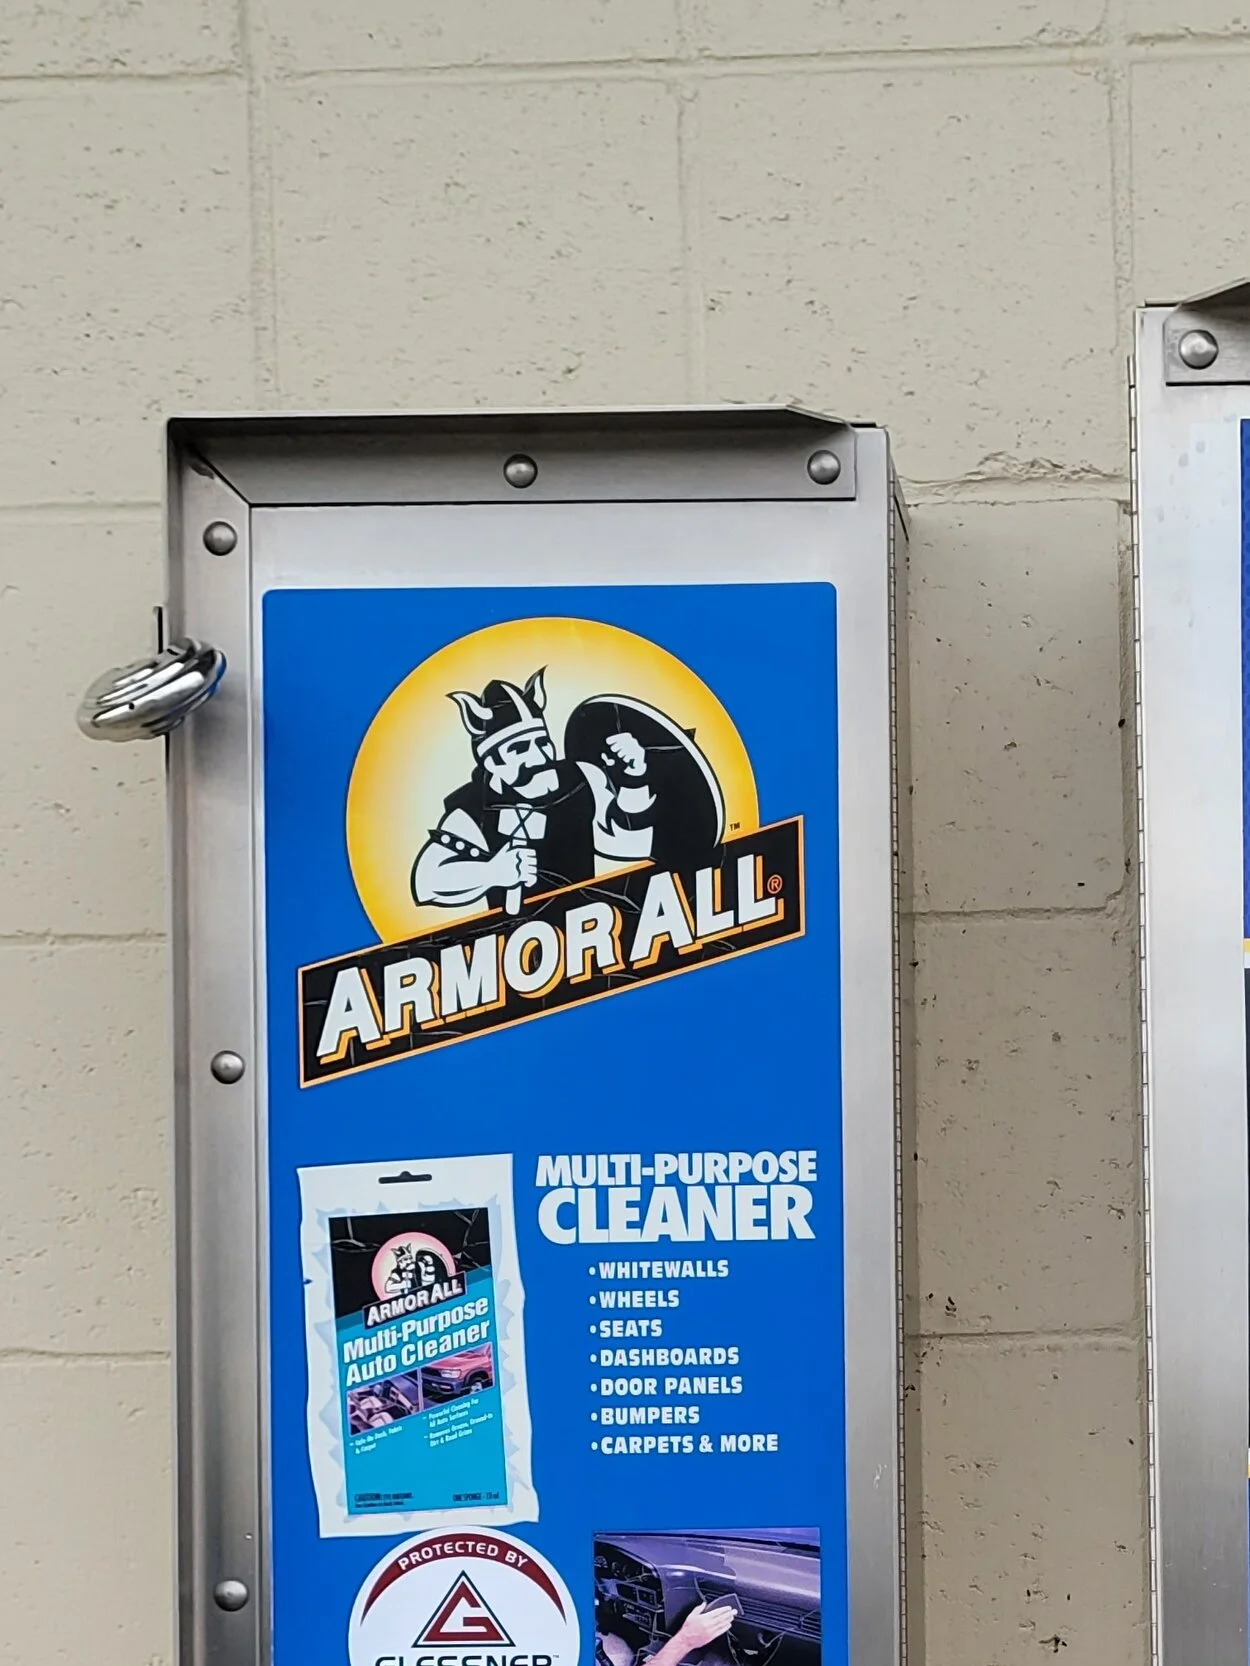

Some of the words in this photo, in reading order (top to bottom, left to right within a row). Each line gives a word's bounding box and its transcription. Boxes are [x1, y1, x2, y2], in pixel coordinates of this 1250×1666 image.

[316, 901, 623, 1064] ARMOR
[629, 853, 785, 968] ALL
[536, 1150, 818, 1187] MULTI-PURPOSE
[537, 1184, 816, 1244] CLEANER
[599, 1260, 730, 1279] WHITEWALLS
[366, 1288, 433, 1327] ARMOR
[430, 1277, 464, 1304] ALL
[599, 1290, 680, 1308] WHEELS
[343, 1297, 489, 1363] Multi-Purpose
[599, 1320, 663, 1338] SEATS
[345, 1353, 397, 1387] Auto
[400, 1320, 491, 1367] Cleaner
[600, 1348, 740, 1367] DASHBOARDS
[600, 1378, 658, 1396] DOOR
[664, 1376, 743, 1395] PANELS
[600, 1406, 700, 1425] BUMPERS
[601, 1435, 694, 1455] CARPETS
[699, 1435, 713, 1454] &
[720, 1434, 779, 1452] MORE
[398, 1540, 499, 1571] PROTECTED
[505, 1549, 529, 1568] BY
